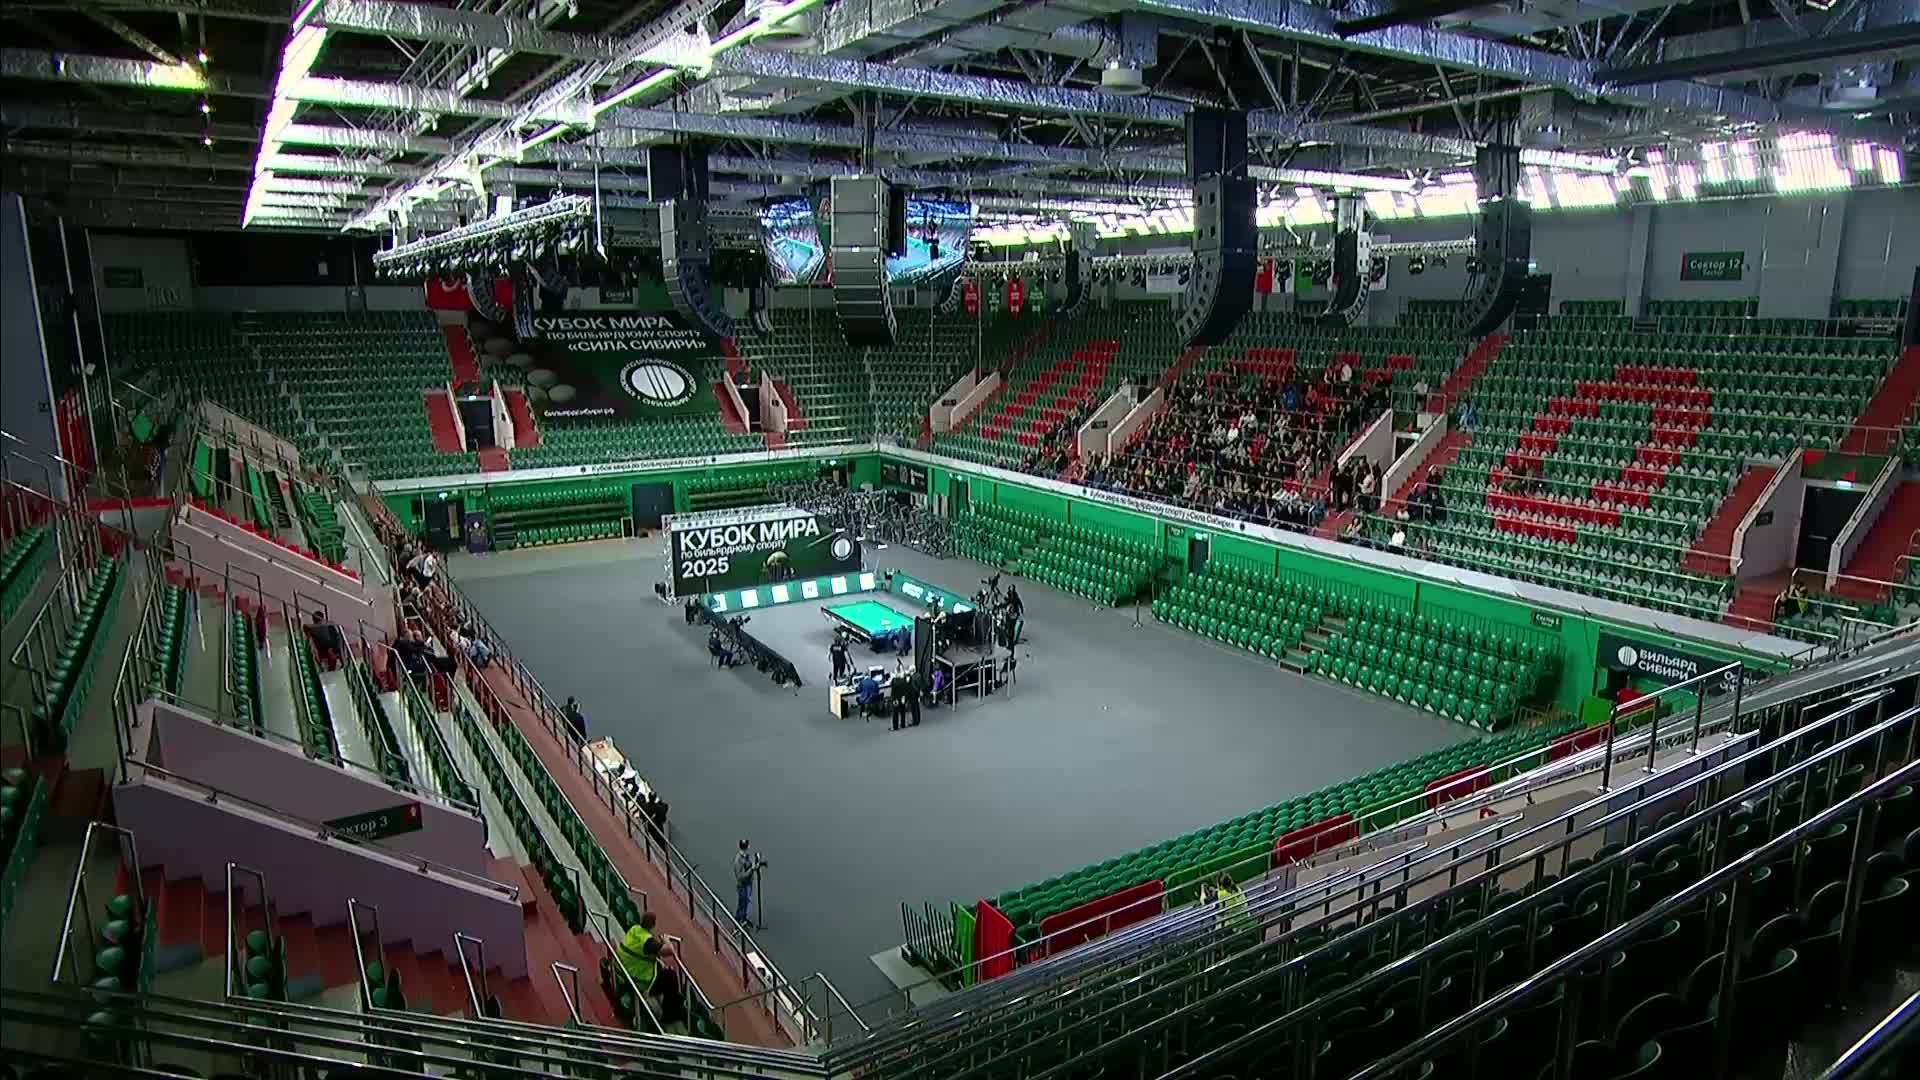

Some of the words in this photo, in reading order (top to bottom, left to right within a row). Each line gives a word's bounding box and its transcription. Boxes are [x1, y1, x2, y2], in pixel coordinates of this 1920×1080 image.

[1690, 259, 1726, 271] Сектор
[1729, 258, 1741, 269] 12
[608, 316, 674, 329] МИРА
[547, 332, 566, 341] ПО
[567, 330, 655, 340] БИЛЬЯРДНОМУ
[656, 329, 701, 338] СПОРТУ
[568, 340, 629, 352] «СИЛА
[629, 338, 707, 350] СИБИРИ»
[680, 524, 757, 551] КУБОК
[760, 517, 820, 541] МИРА
[681, 551, 693, 561] по
[694, 544, 756, 558] бильярдному
[756, 539, 788, 552] спорту
[682, 556, 730, 579] 2025
[1637, 659, 1690, 681] СИБИРИ
[1639, 648, 1698, 674] БИЛЬЯРД
